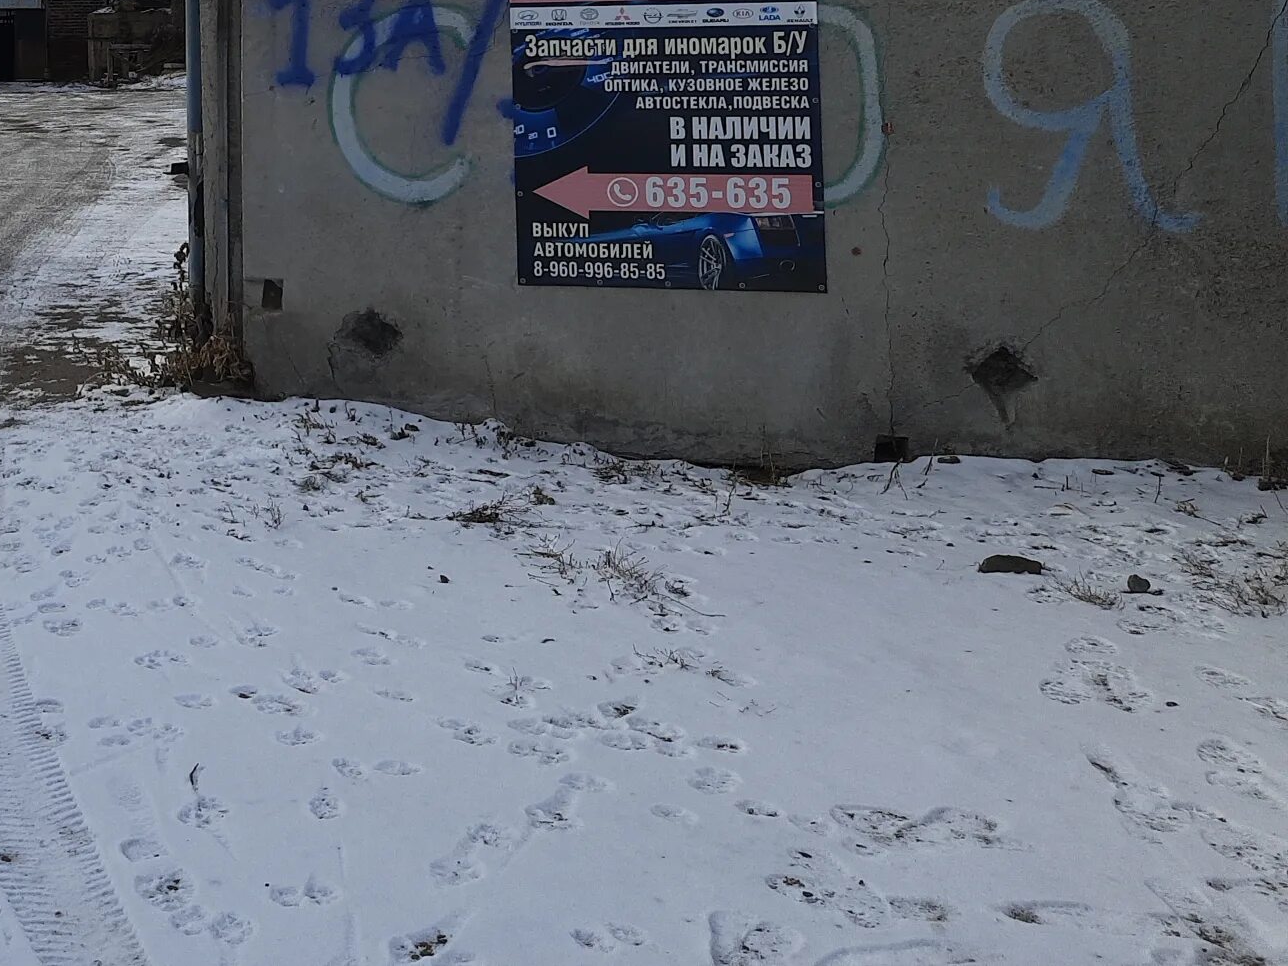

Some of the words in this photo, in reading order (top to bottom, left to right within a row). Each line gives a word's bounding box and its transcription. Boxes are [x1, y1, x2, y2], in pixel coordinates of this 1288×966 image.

[525, 34, 616, 57] Запчасти
[623, 38, 658, 57] для
[665, 36, 766, 59] иномарок
[773, 31, 807, 55] Б/У
[611, 61, 695, 75] ДВИГАТЕЛИ,
[699, 60, 808, 73] ТРАНСМИССИЯ
[604, 79, 663, 94] ОПТИКА,
[668, 78, 743, 92] КУЗОВНОЕ
[747, 77, 809, 91] ЖЕЛЕЗО
[669, 117, 686, 140] В
[692, 116, 811, 140] НАЛИЧИИ
[670, 144, 687, 167] И
[692, 144, 726, 167] НА
[730, 144, 812, 168] ЗАКАЗ
[645, 177, 791, 209] 635-635
[532, 222, 589, 238] ВЫКУП
[533, 240, 653, 259] АВТОМОБИЛЕЙ
[533, 261, 665, 280] 8-960-996-85-85
